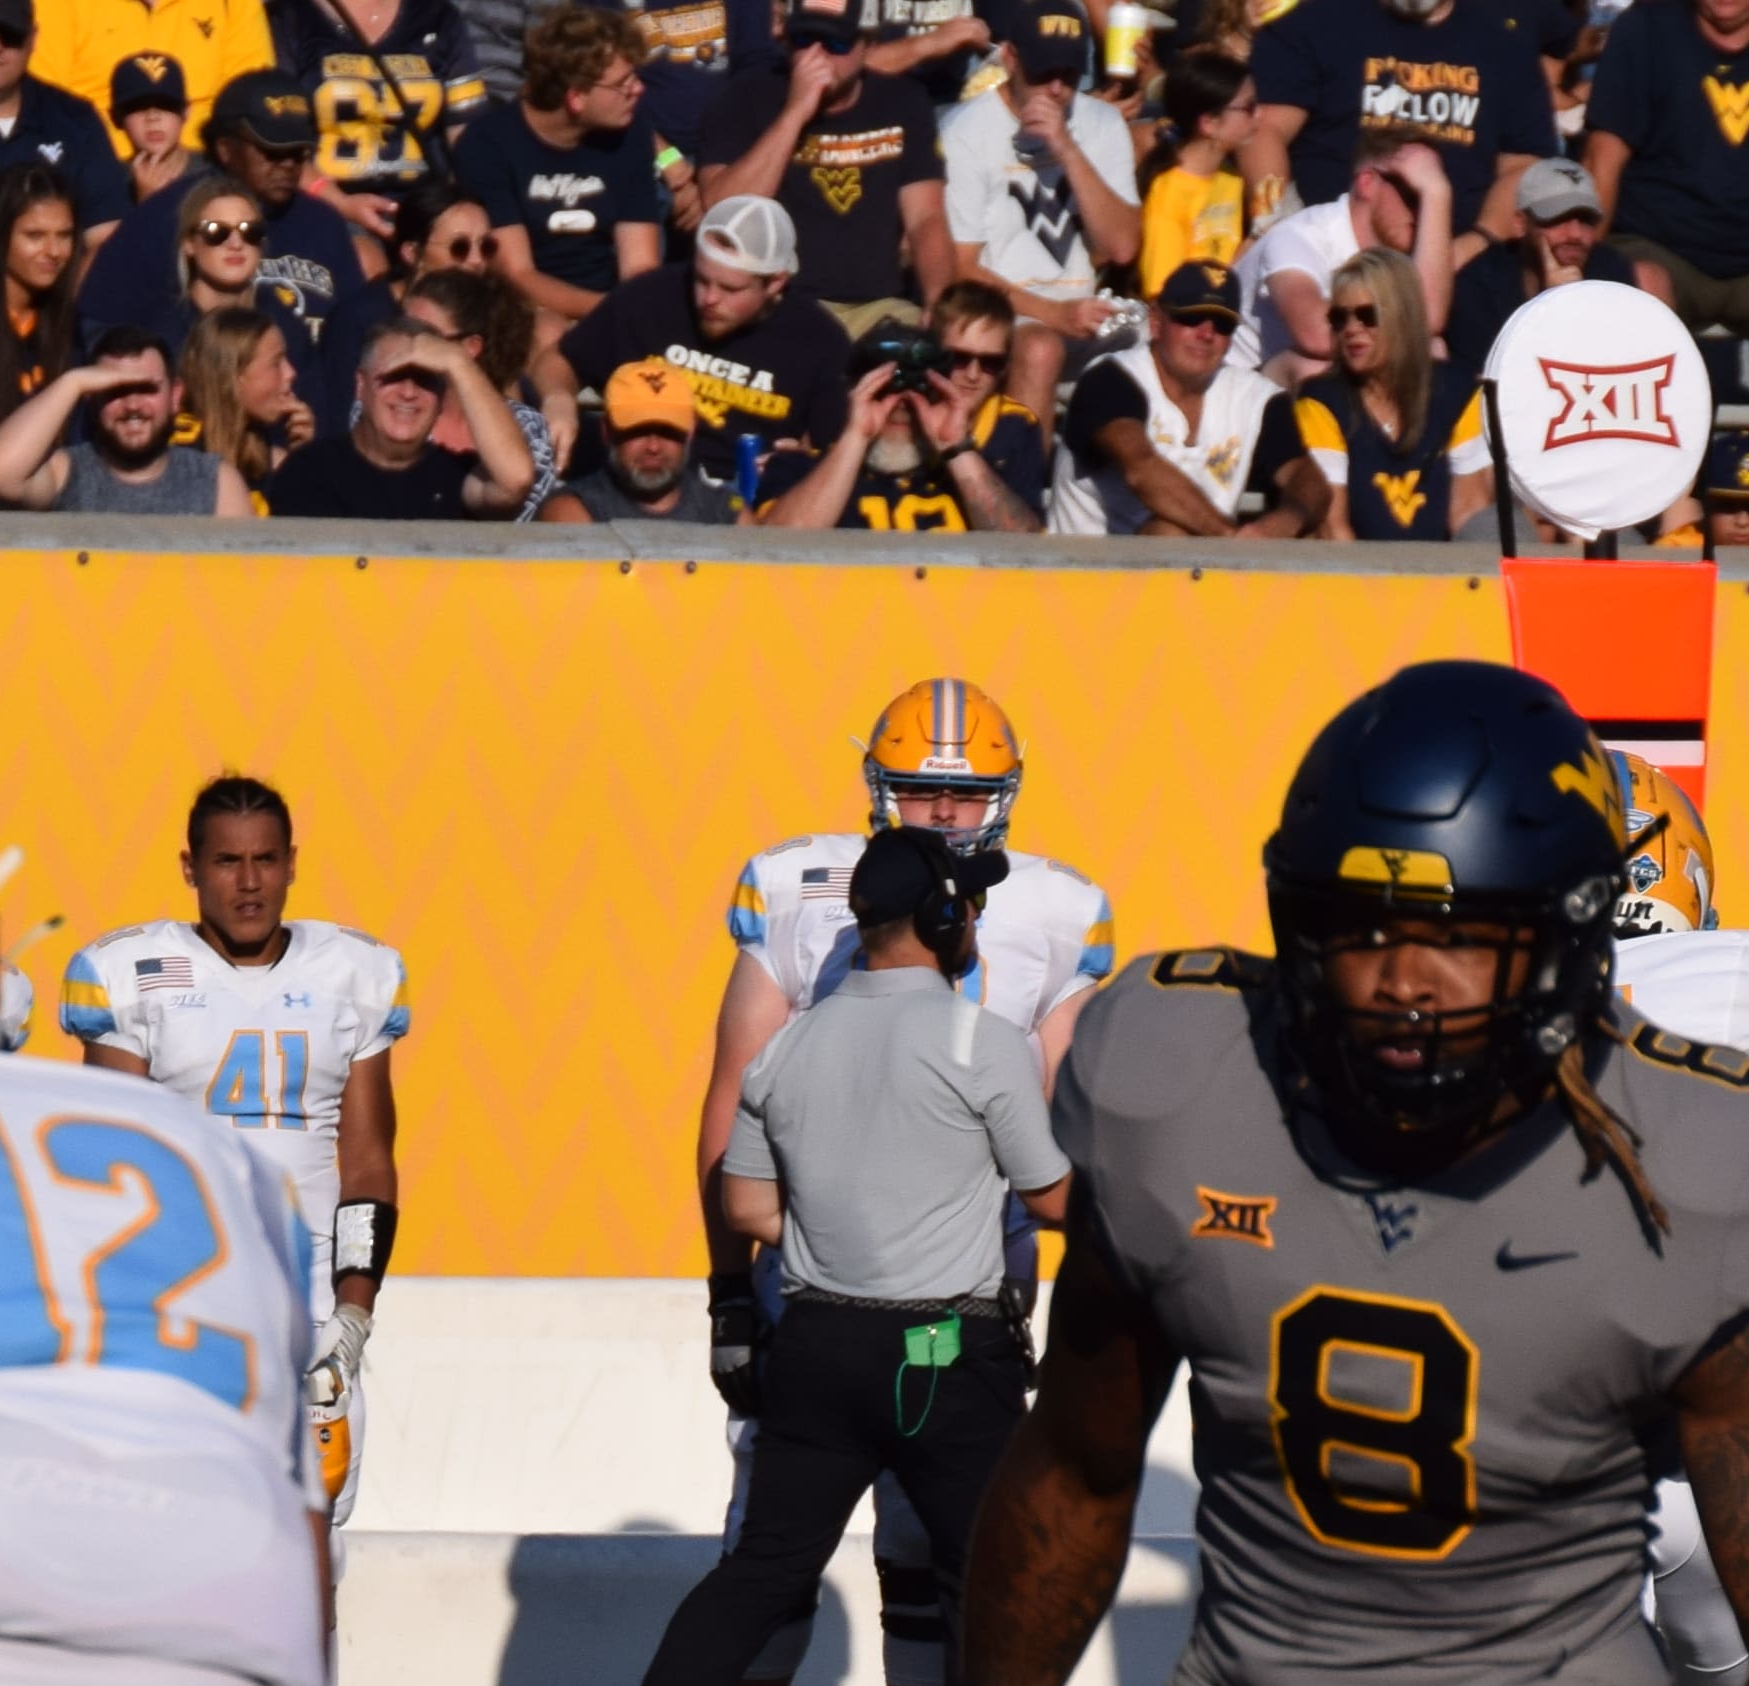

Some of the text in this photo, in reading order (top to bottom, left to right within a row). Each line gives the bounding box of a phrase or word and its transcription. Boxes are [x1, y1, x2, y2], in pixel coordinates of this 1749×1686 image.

[665, 344, 774, 393] ONCE A
[672, 364, 791, 419] NTAINEER
[206, 1029, 310, 1131] 41
[1269, 1284, 1481, 1562] 8
